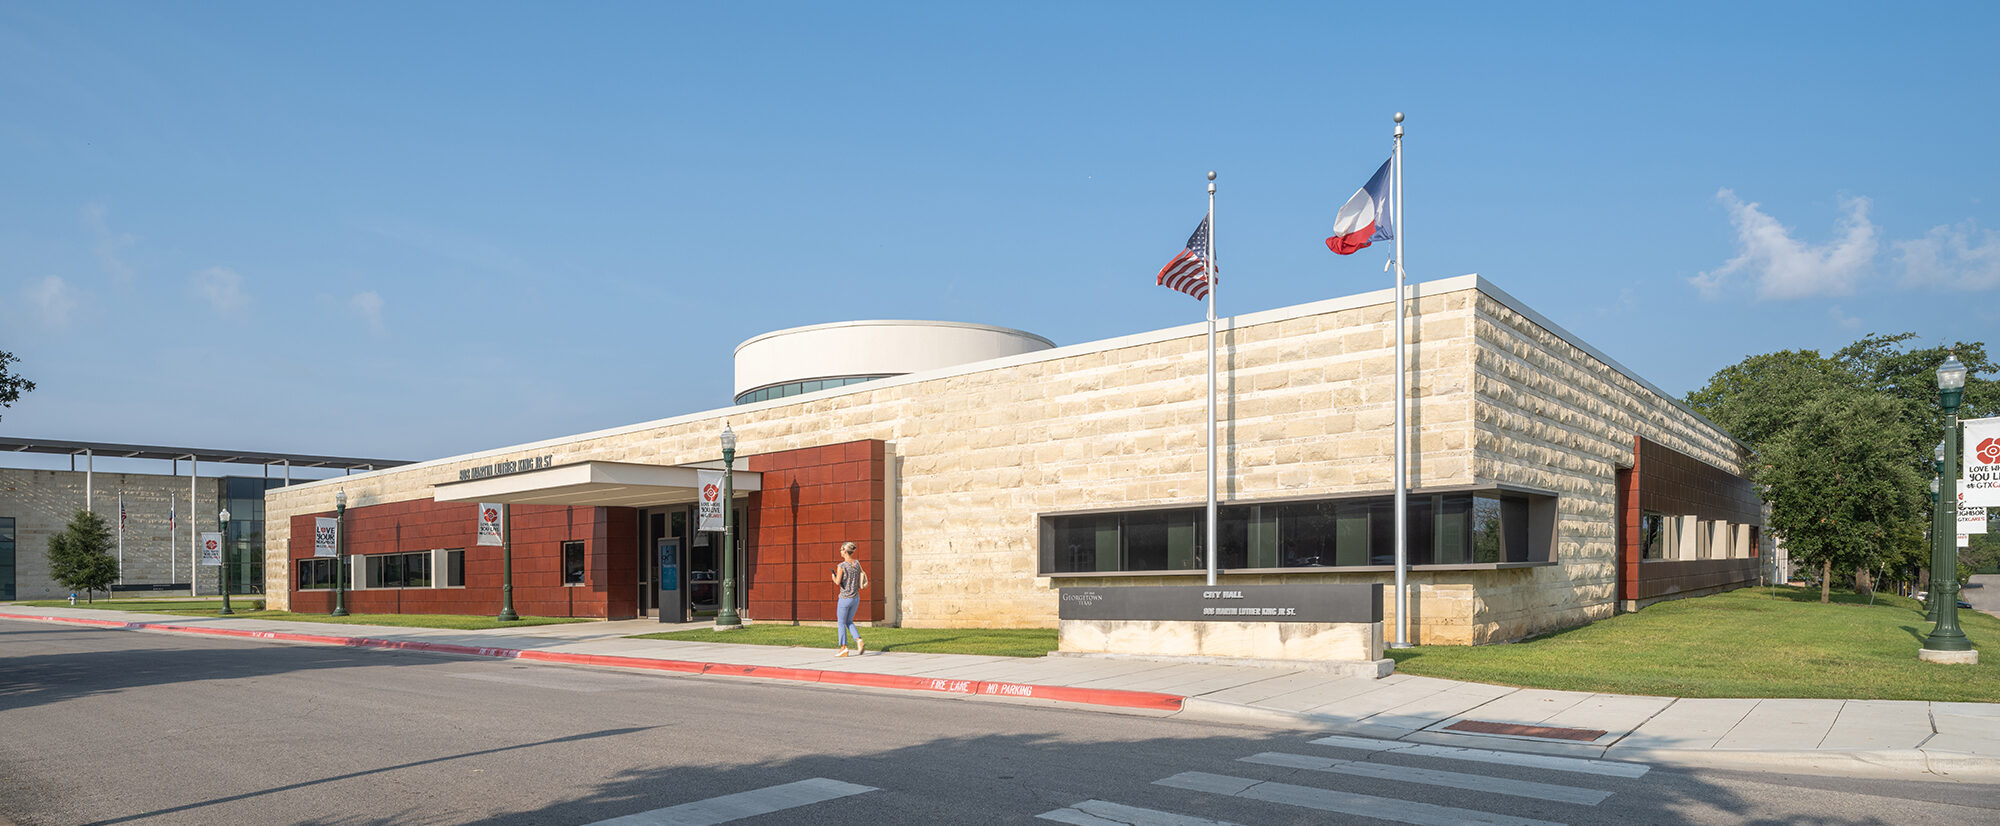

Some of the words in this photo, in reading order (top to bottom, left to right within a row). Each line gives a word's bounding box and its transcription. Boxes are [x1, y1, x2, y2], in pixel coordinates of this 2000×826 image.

[471, 465, 493, 479] MARTIN
[494, 461, 517, 476] LUTHER
[518, 458, 534, 472] KING
[535, 456, 543, 469] JR
[544, 455, 553, 467] ST
[1969, 472, 1990, 481] YOU
[316, 526, 335, 534] LOVE
[316, 533, 335, 541] YOUR
[1203, 591, 1221, 599] CITY
[1223, 591, 1244, 599] HALL
[1216, 607, 1238, 616] MARTIN
[1239, 607, 1261, 616] LUTHER
[1262, 607, 1277, 616] KING
[1278, 607, 1286, 616] JR
[930, 680, 948, 690] FIRE
[950, 681, 970, 692] LANE
[986, 683, 999, 694] NO
[1000, 684, 1033, 696] PARKING
